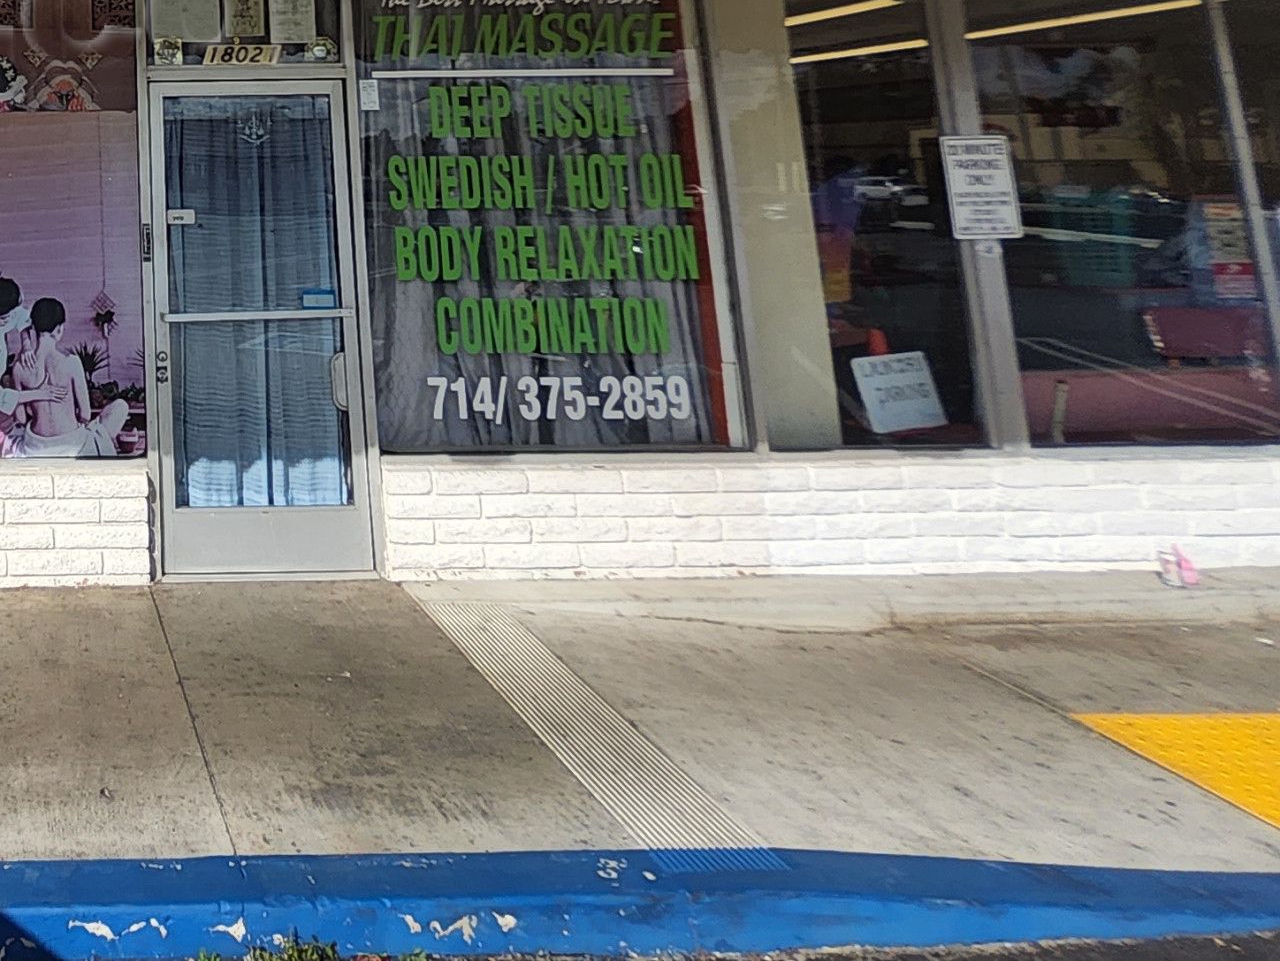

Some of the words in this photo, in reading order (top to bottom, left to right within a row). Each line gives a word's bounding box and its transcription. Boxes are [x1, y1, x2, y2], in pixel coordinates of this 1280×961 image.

[371, 13, 465, 63] THAI
[472, 11, 676, 61] MASSAGE
[428, 86, 511, 138] DEEP
[522, 85, 638, 138] TISSUE
[387, 155, 536, 210] SWEDISH
[545, 155, 555, 215] /
[564, 153, 629, 210] HOT
[638, 153, 695, 210] OIL
[394, 225, 483, 283] BODY
[494, 224, 700, 282] RELAXATION
[436, 296, 671, 356] COMBINATION
[427, 376, 508, 425] 714/
[517, 375, 691, 422] 375-2859
